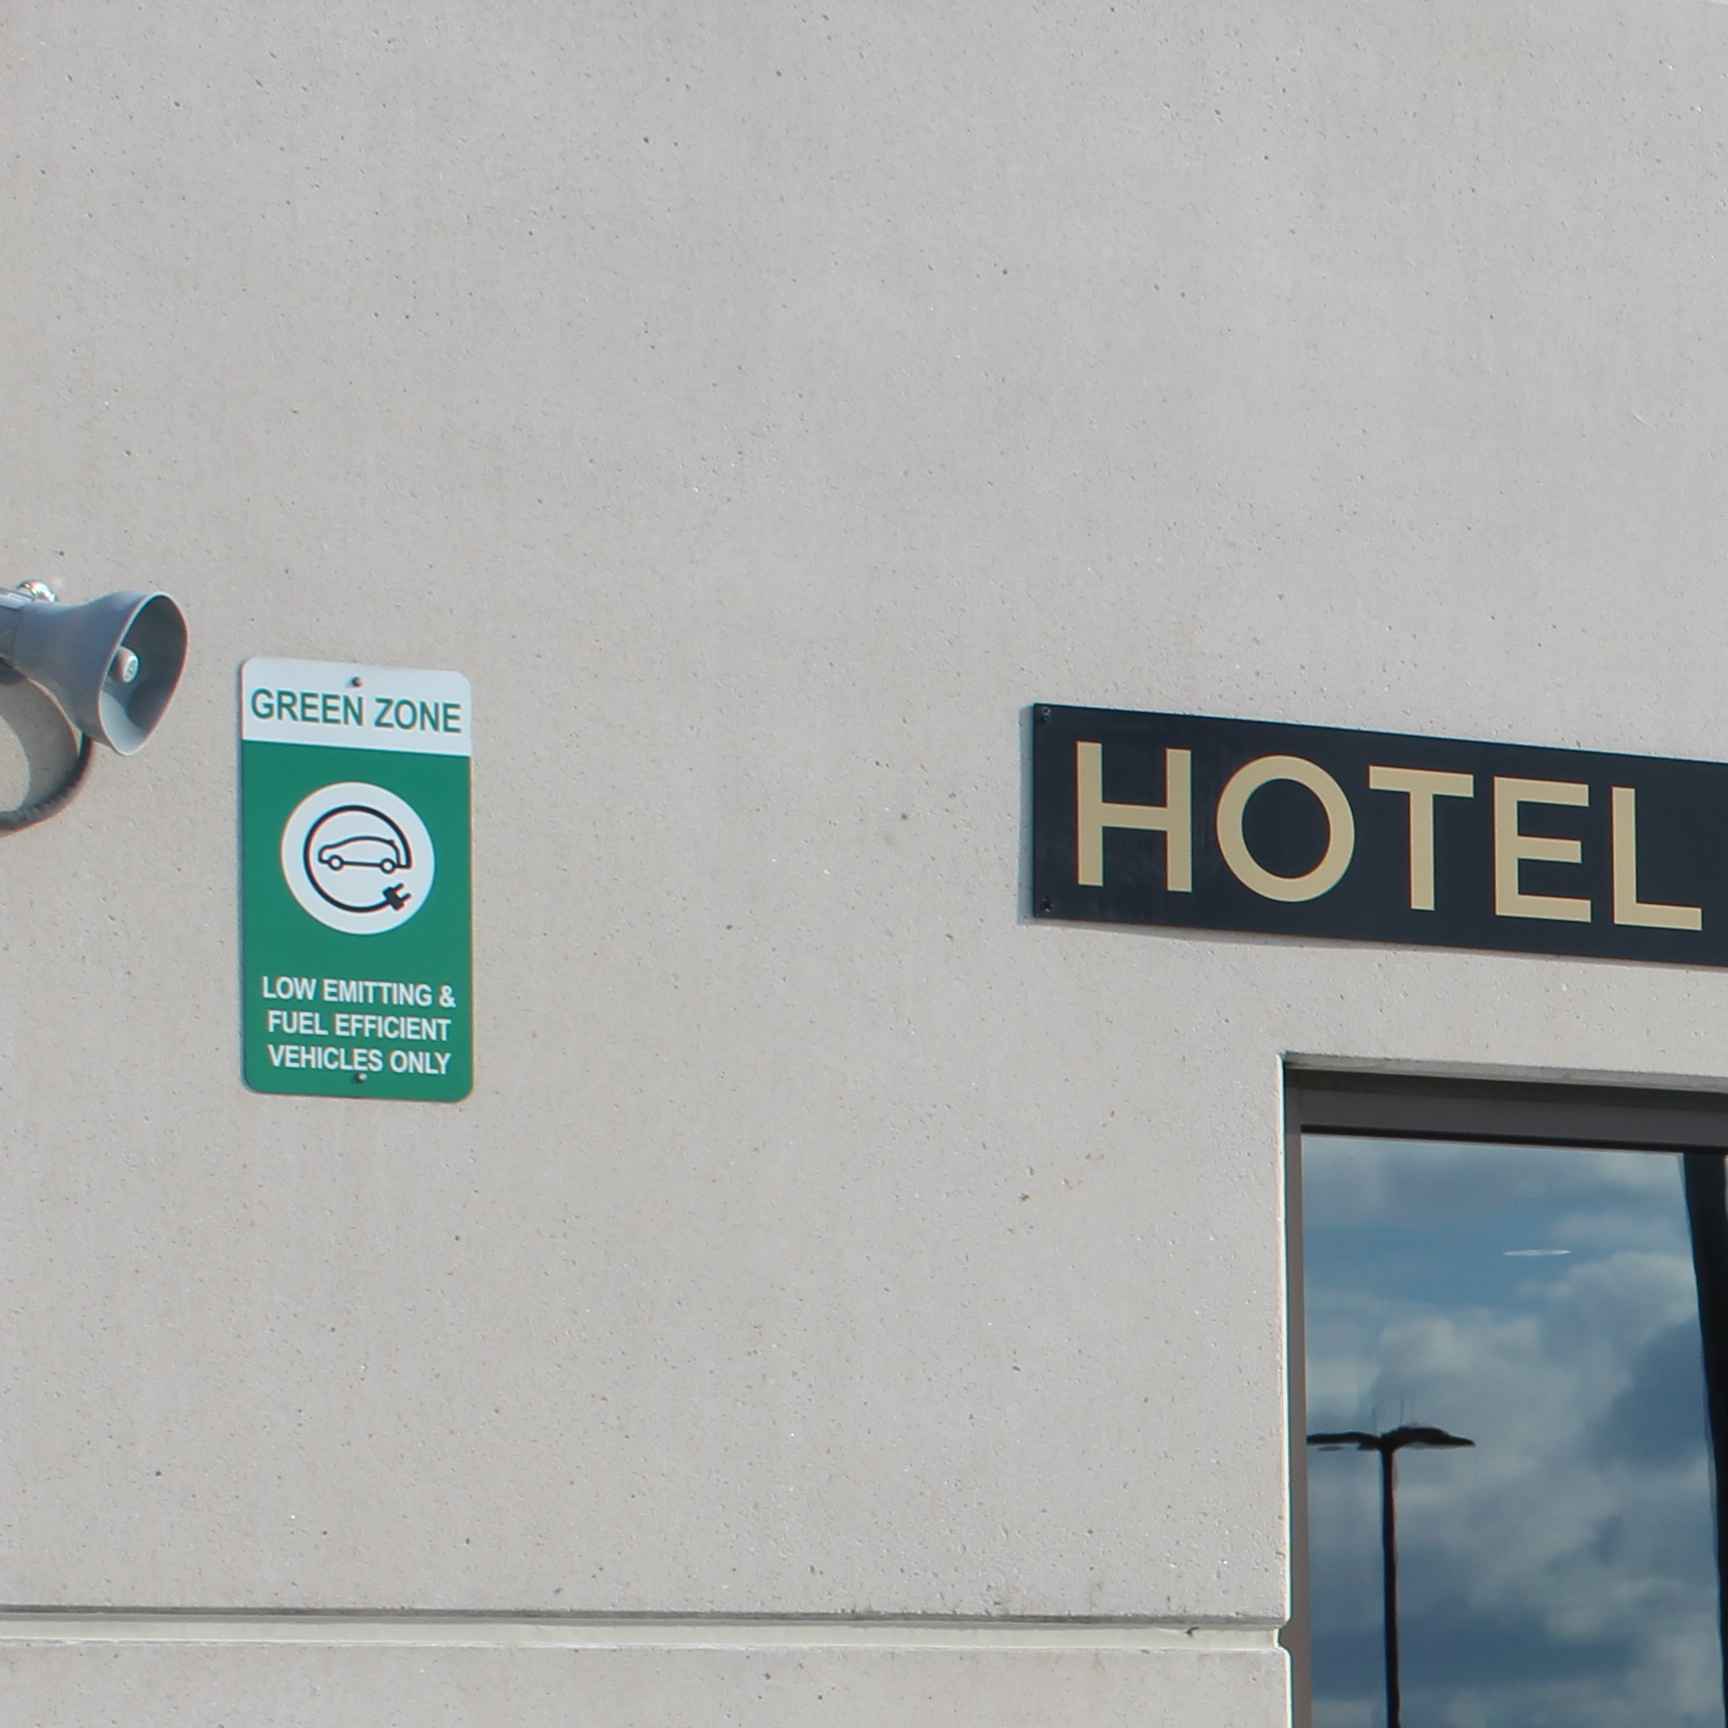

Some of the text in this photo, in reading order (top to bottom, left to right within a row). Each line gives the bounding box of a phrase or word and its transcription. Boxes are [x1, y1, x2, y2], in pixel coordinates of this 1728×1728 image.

[250, 687, 462, 734] GREEN ZONE
[1075, 740, 1703, 932] HOTEL
[261, 975, 457, 1009] LOW EMITTING &
[267, 1009, 452, 1042] FUEL EFFICIENT
[266, 1043, 452, 1076] VEHICLES ONLY
